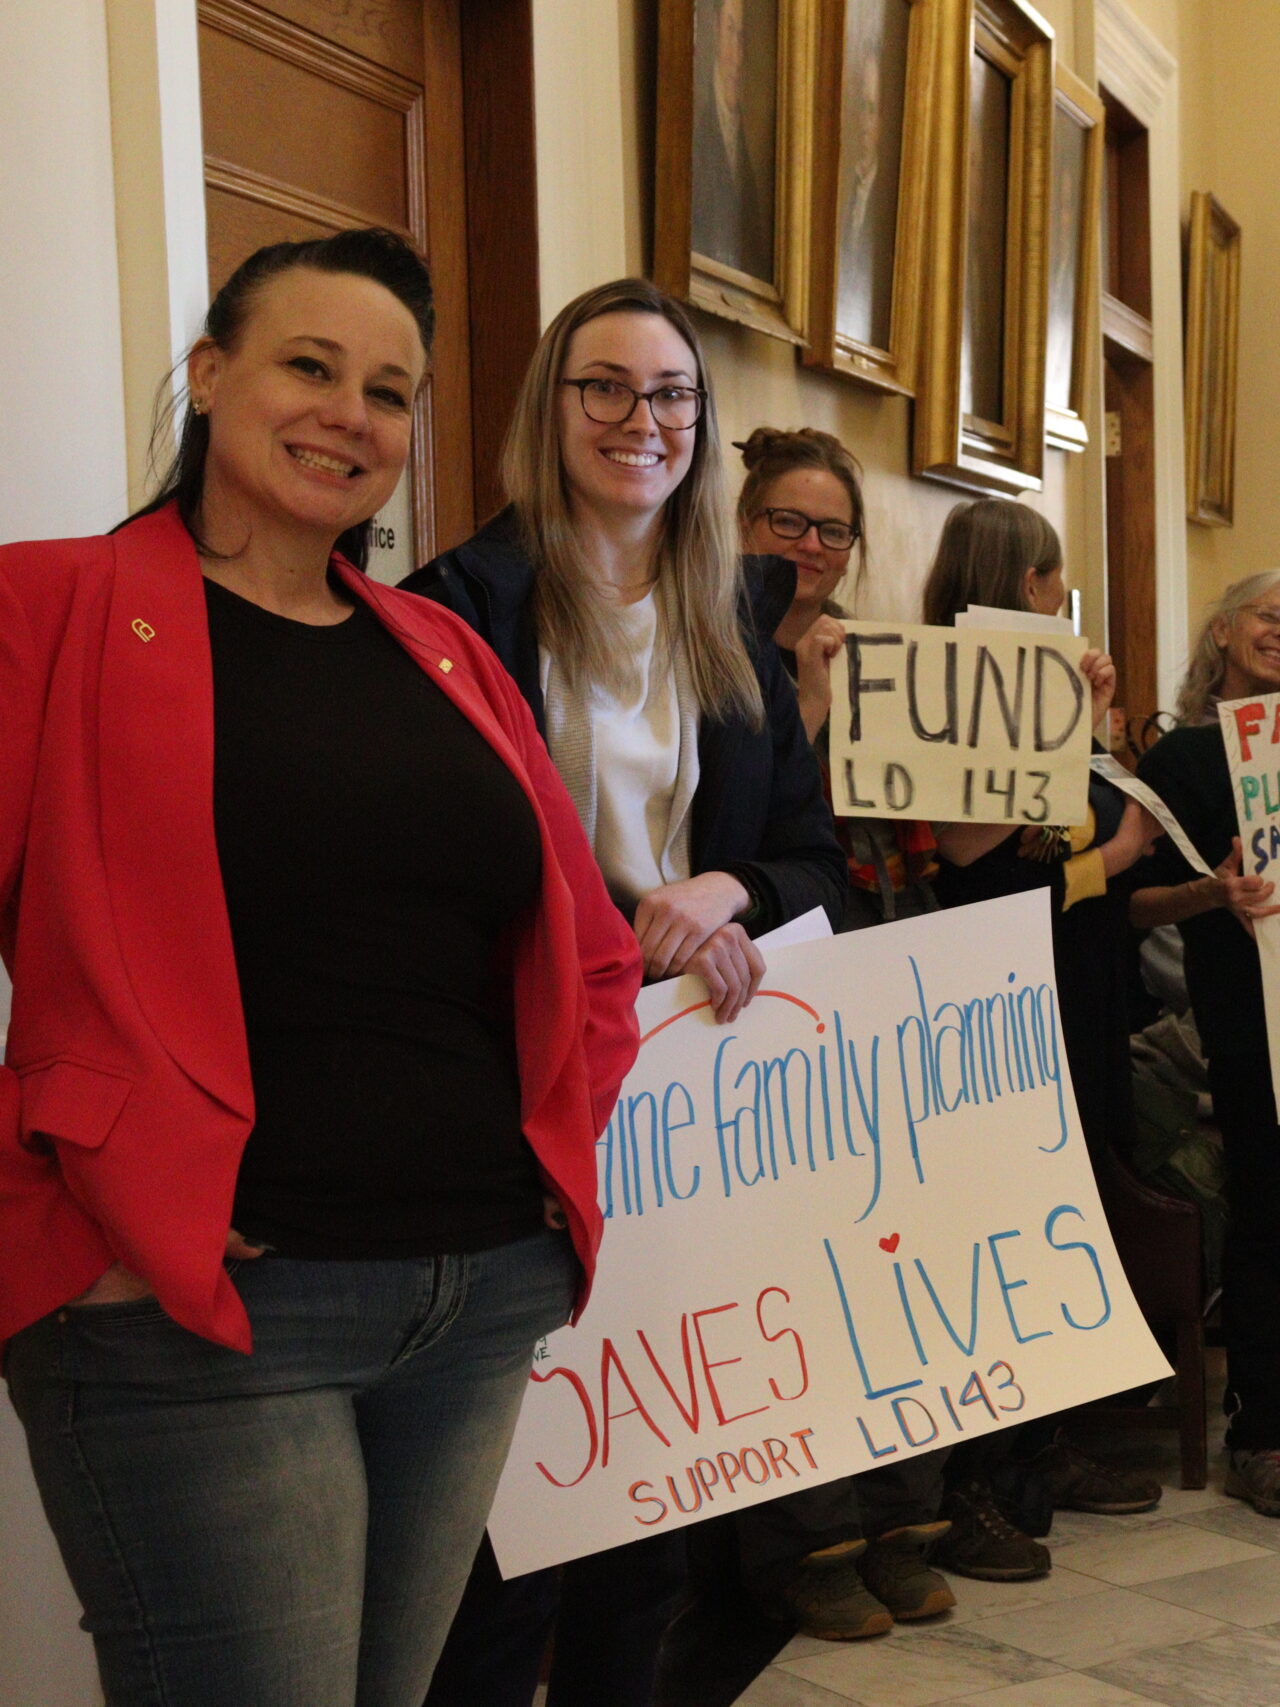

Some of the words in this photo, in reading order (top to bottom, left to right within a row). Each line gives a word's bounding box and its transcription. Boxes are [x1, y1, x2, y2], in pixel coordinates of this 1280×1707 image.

[845, 632, 1085, 752] FUND
[843, 757, 914, 811] LD
[963, 768, 1051, 823] 143
[712, 1010, 880, 1223] family
[896, 955, 1069, 1184] planning
[529, 1286, 809, 1487] SAVES
[823, 1204, 1112, 1400] LiVES
[627, 1428, 819, 1526] SUPPORT
